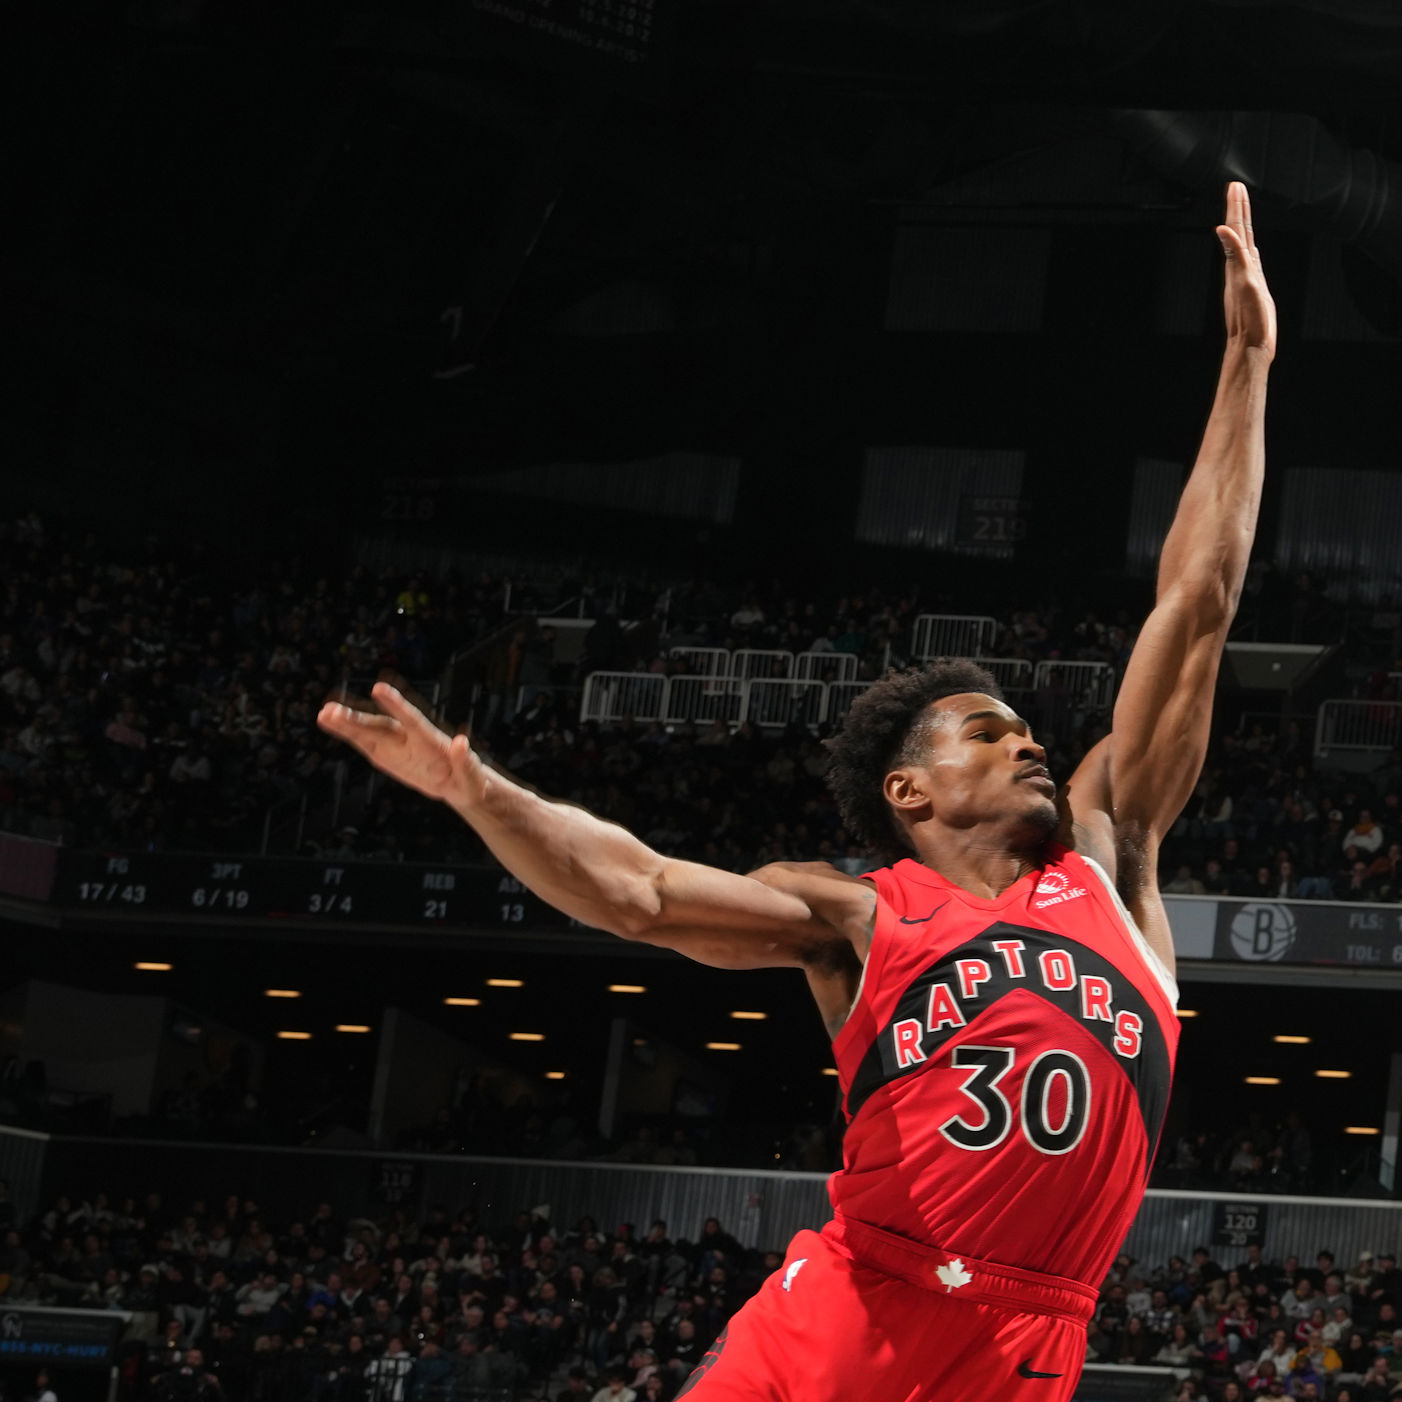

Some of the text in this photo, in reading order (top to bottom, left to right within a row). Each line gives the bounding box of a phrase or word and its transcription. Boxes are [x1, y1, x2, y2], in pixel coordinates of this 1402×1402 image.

[323, 867, 344, 886] FT
[423, 873, 456, 890] REB
[1036, 886, 1087, 909] Sun Life
[424, 900, 448, 919] 21
[501, 904, 525, 922] 13
[892, 939, 1144, 1069] RAPTORS
[937, 1044, 1093, 1156] 30
[1224, 1214, 1257, 1230] 120
